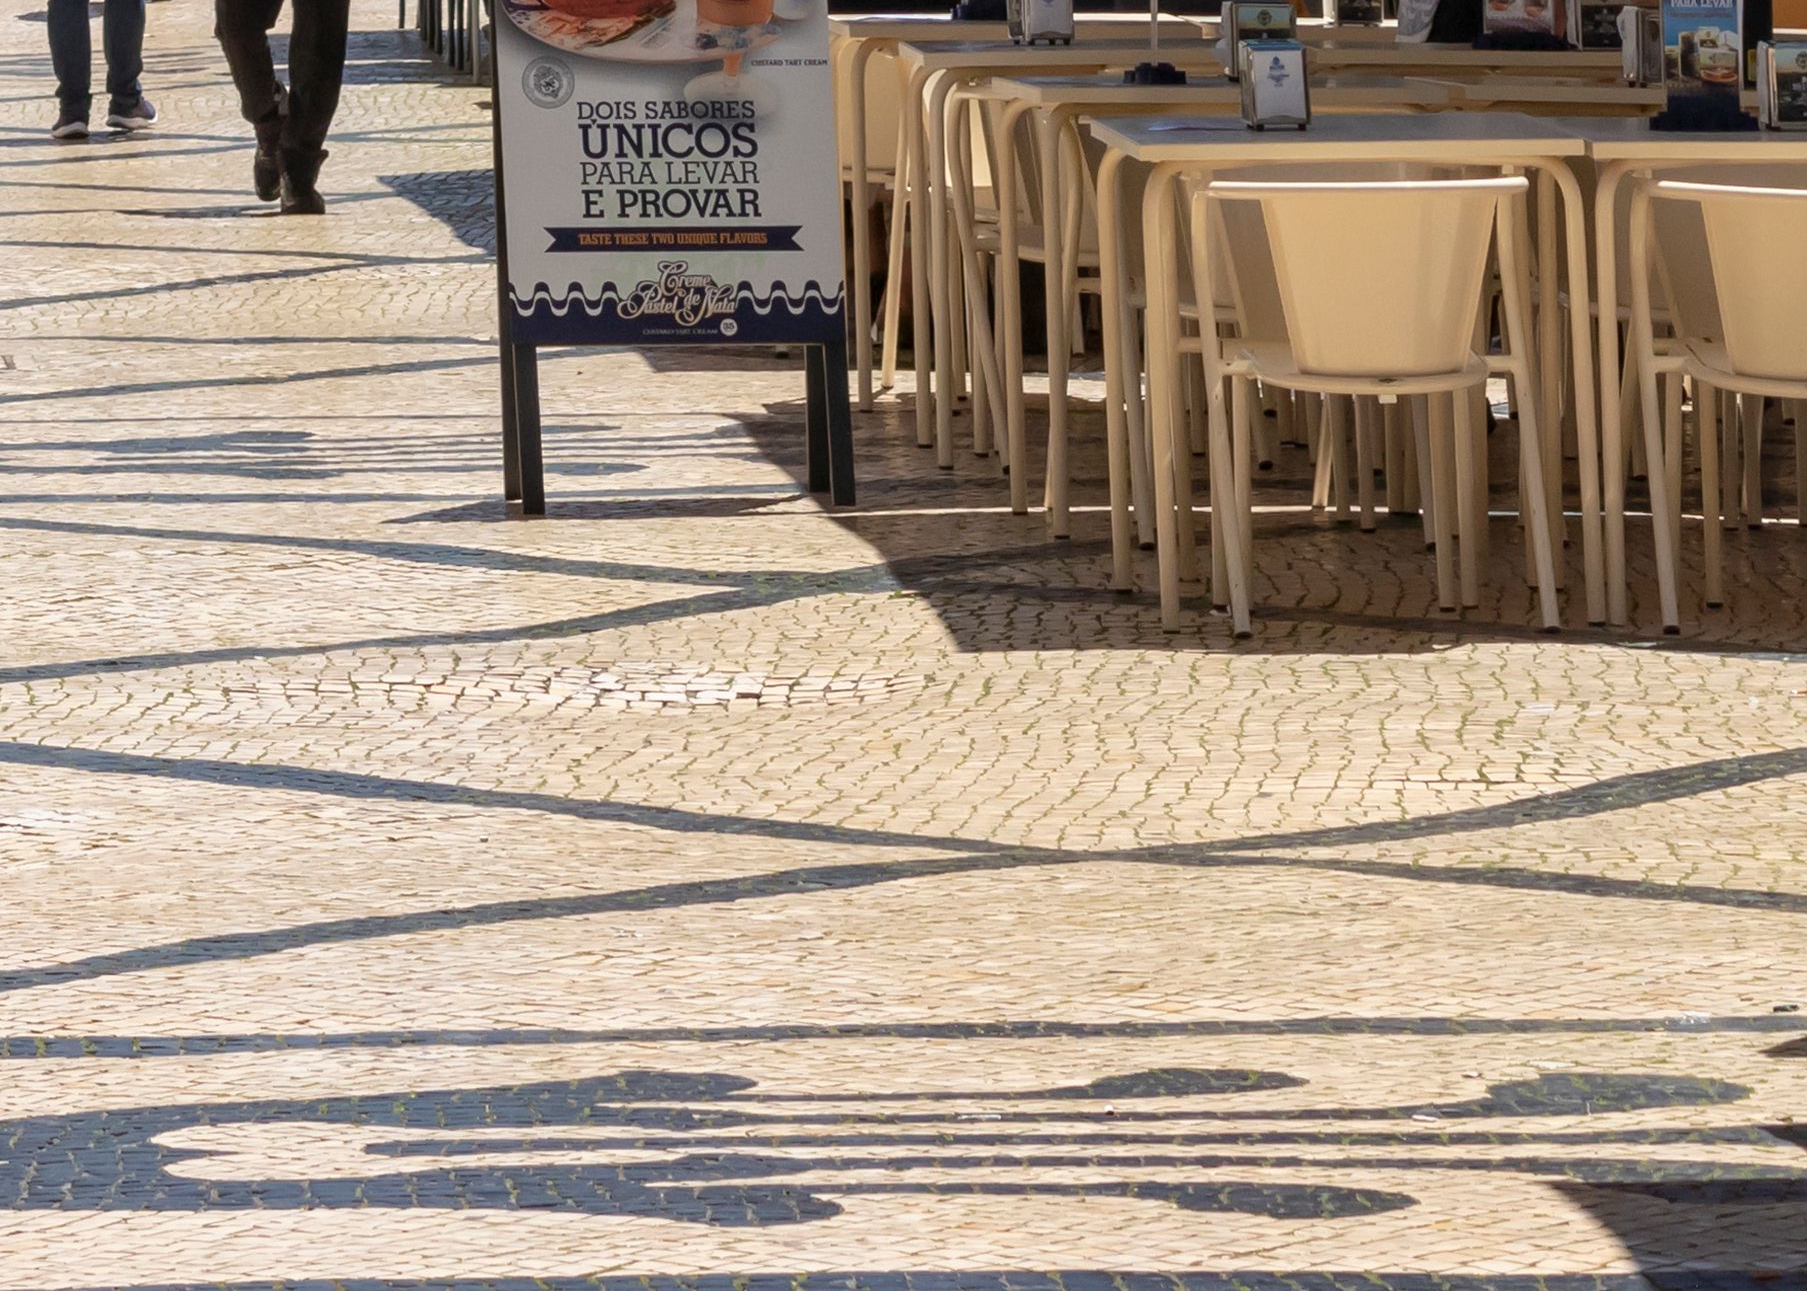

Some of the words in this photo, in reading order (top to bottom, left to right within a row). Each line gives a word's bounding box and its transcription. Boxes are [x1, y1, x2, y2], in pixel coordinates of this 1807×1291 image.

[577, 101, 636, 120] DOIS
[645, 101, 755, 119] SABORES
[578, 119, 758, 159] ÚNICOS
[580, 162, 656, 185] PARA
[666, 161, 760, 184] LEVAR
[583, 189, 604, 218] E
[617, 189, 762, 218] PROVAR
[577, 233, 612, 245] TASTE
[614, 233, 649, 245] THESE
[651, 233, 675, 245] TWO
[676, 233, 718, 245] UNIQUE
[719, 233, 768, 245] FLAVORS
[659, 261, 711, 295] Creme
[618, 281, 677, 318] Pastel
[682, 284, 736, 323] Nata
